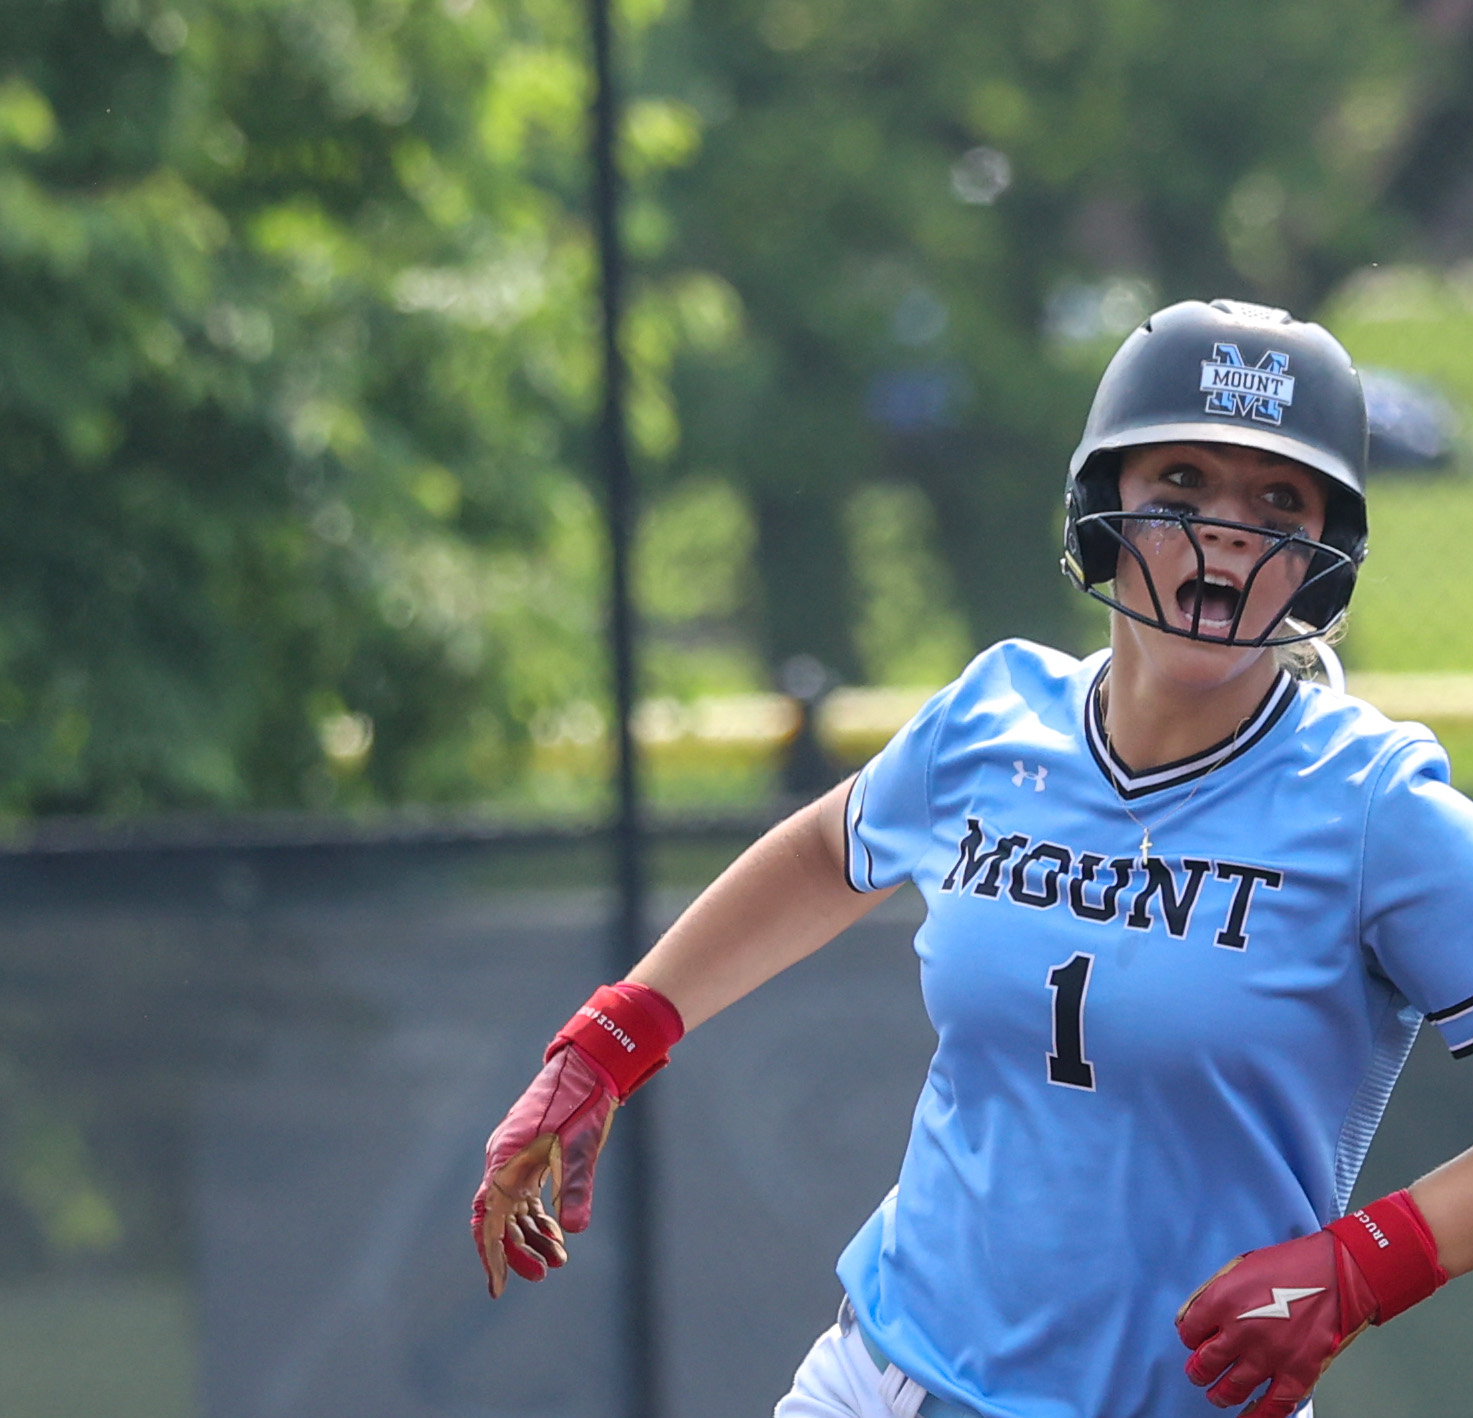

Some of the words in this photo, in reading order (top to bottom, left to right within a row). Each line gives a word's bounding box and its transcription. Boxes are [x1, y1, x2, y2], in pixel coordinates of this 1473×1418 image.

[1212, 368, 1284, 396] MOUNT
[939, 817, 1284, 953] MOUNT
[596, 1013, 637, 1053] BRUCE
[1044, 950, 1097, 1093] 1
[1353, 1209, 1389, 1249] BRUCE
